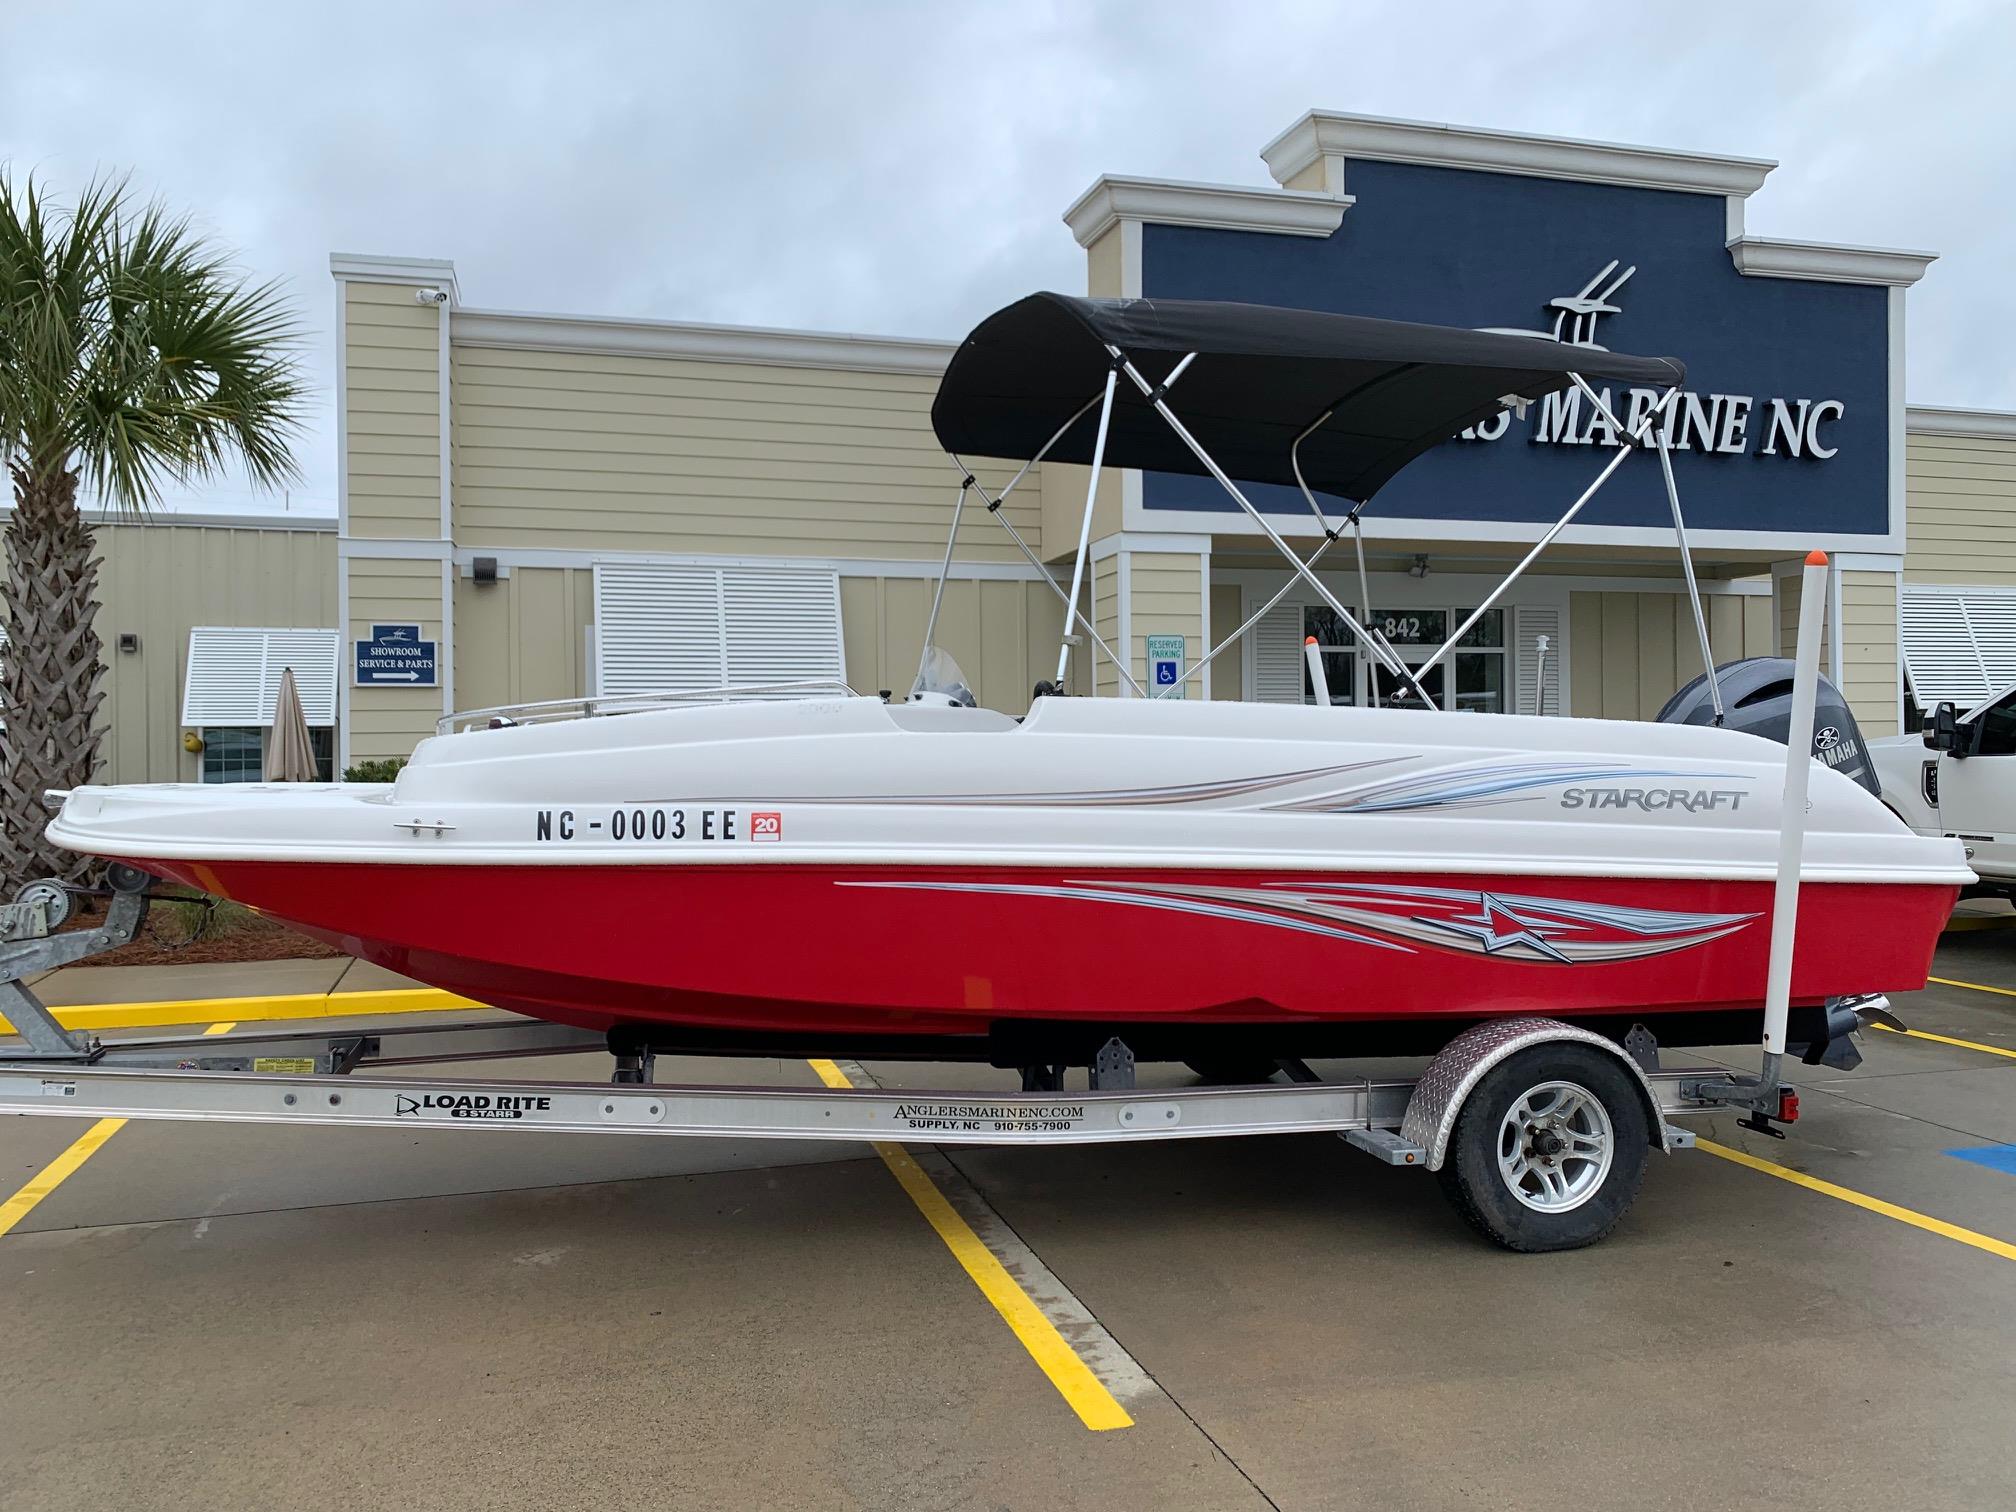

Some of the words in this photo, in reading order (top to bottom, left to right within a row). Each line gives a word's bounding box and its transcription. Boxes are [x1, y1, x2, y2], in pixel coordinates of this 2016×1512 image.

[1536, 386, 1753, 454] MARINE
[1761, 399, 1845, 459] NC
[1384, 617, 1421, 637] 842
[370, 647, 422, 656] SHOWROOM
[1149, 640, 1183, 649] RESERVED
[1151, 649, 1181, 659] PARKING
[359, 659, 396, 668] SERVICE
[397, 660, 404, 668] &
[405, 659, 433, 668] PARTS
[1812, 738, 1859, 767] AMAHA
[1560, 788, 1750, 813] STARCRAFT
[536, 810, 575, 841] NC
[702, 810, 736, 840] EE
[754, 814, 778, 832] 20
[423, 1095, 490, 1109] LOAD
[496, 1097, 551, 1111] RITE
[470, 1110, 515, 1118] STARR
[893, 1104, 1084, 1119] ANGLERSMARINENC.COM
[909, 1119, 959, 1129] SUPPLY,
[963, 1121, 980, 1130] NC
[994, 1122, 1070, 1131] 910-755-7900
